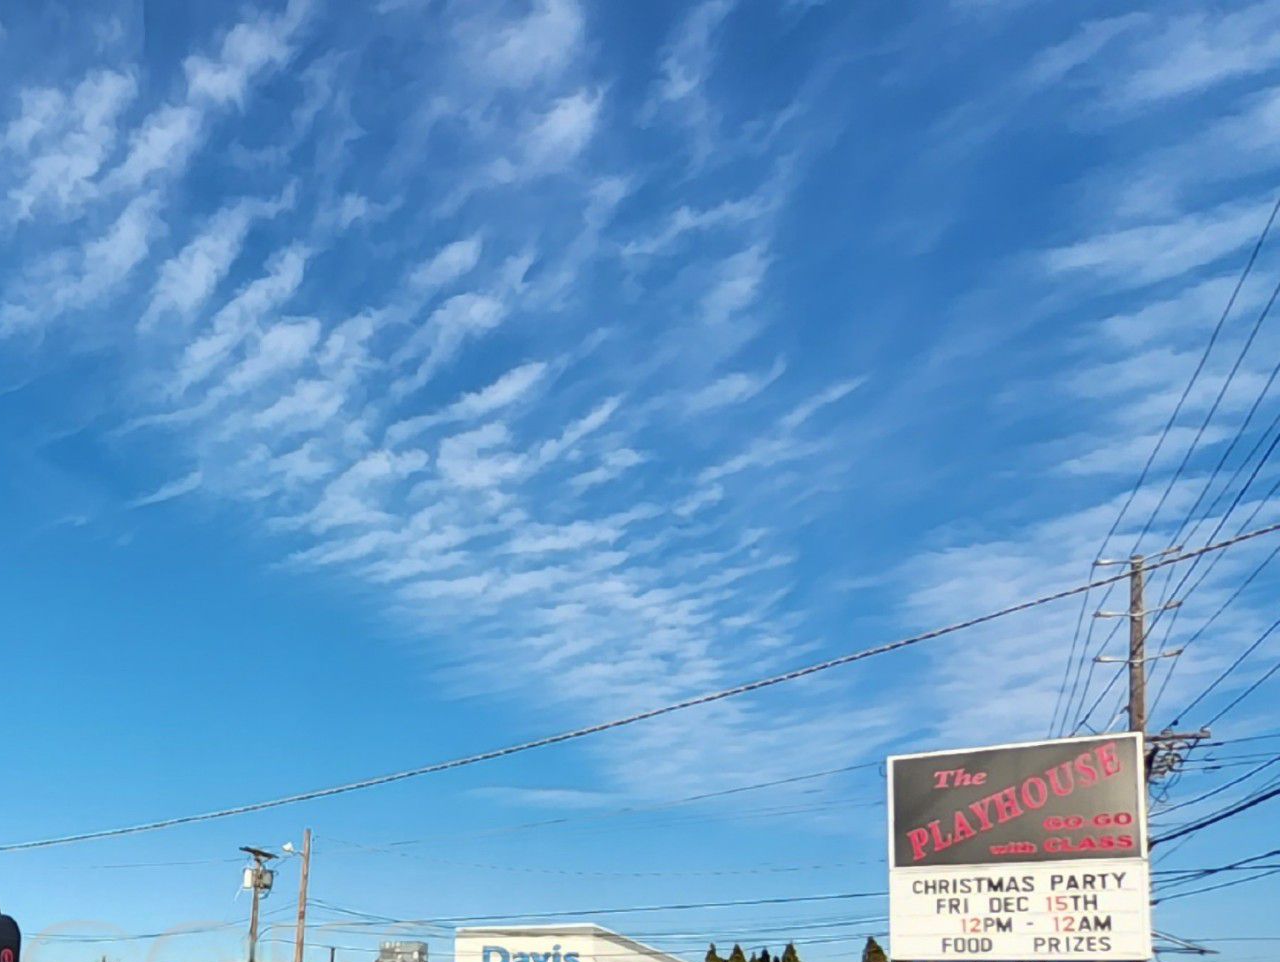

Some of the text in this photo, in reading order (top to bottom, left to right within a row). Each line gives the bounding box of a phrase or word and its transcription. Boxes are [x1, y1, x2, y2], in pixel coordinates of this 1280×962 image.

[933, 767, 988, 789] The
[907, 742, 1121, 860] PLAYHOUSE
[989, 834, 1133, 856] with CLASS
[911, 871, 1127, 895] CHRISTMAS PARTY
[936, 895, 1098, 914] FRI DEC 15TH
[960, 916, 1014, 934] 12PM
[1052, 915, 1112, 932] 12AM
[941, 936, 1112, 953] FOOD PRIZES
